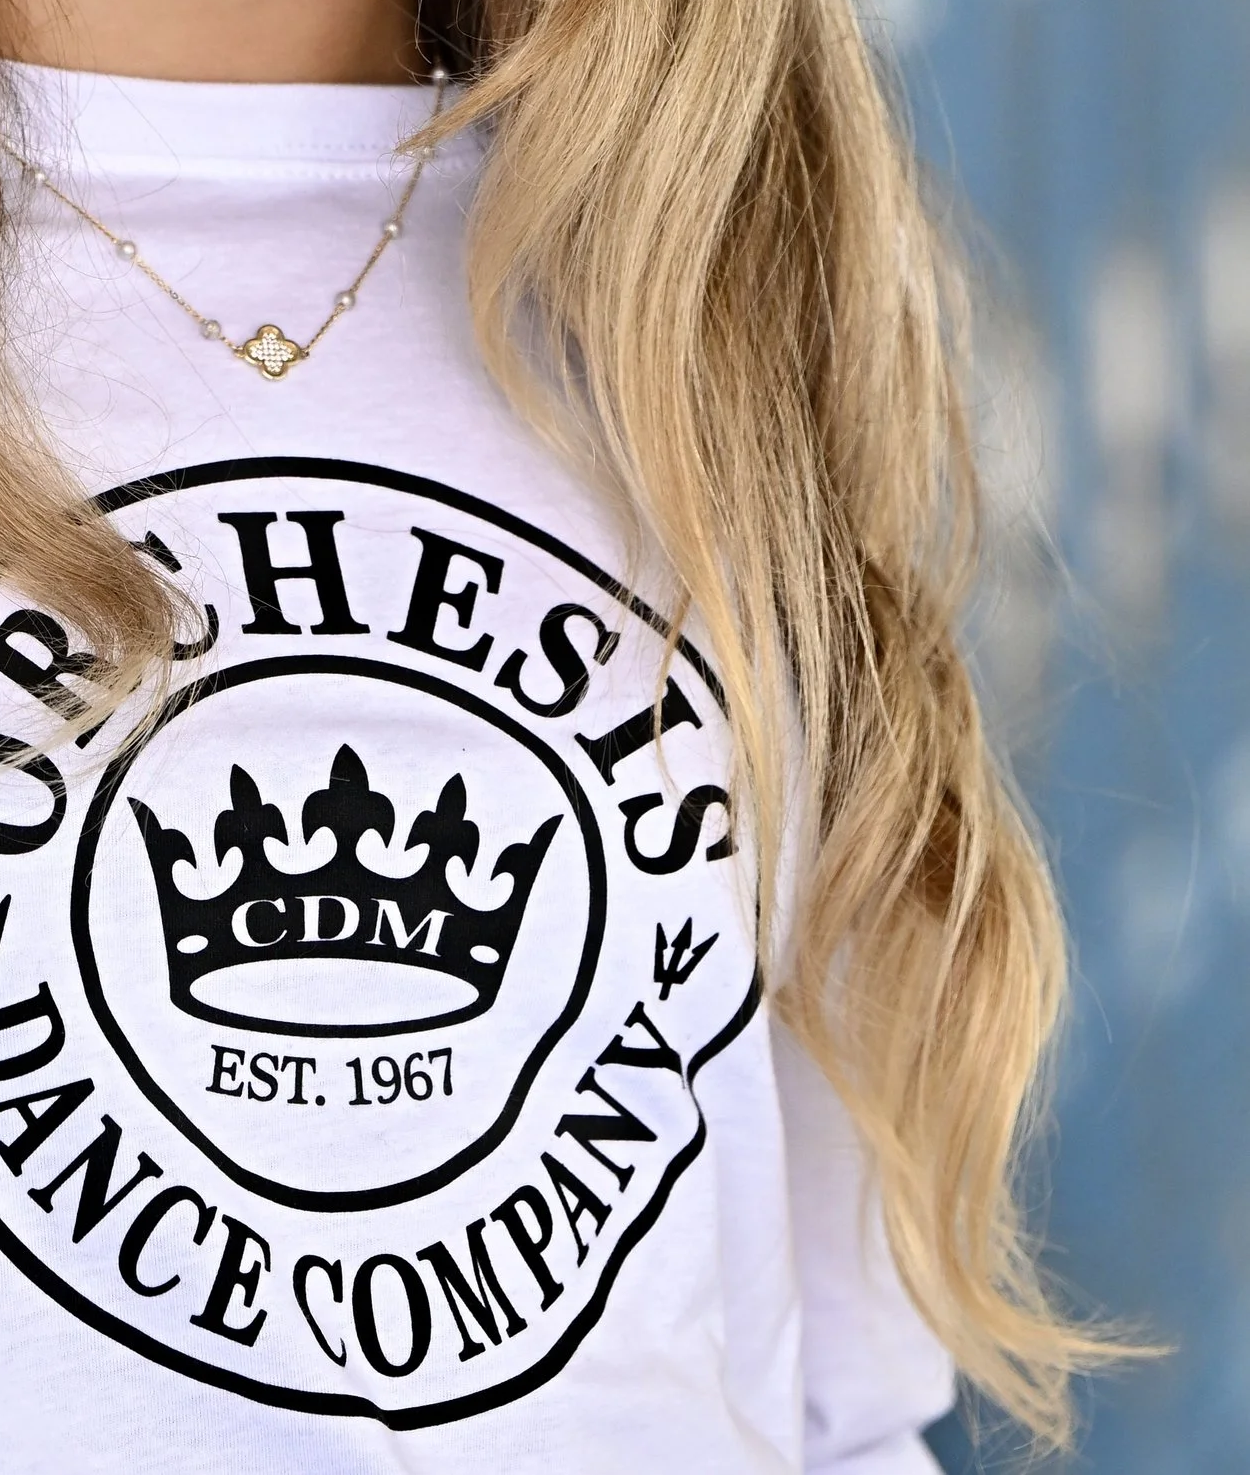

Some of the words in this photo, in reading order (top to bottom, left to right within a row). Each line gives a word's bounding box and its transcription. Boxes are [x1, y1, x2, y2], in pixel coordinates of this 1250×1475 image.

[231, 895, 454, 957] CDM
[206, 1044, 326, 1106] EST.
[345, 1047, 453, 1106] 1967
[292, 1000, 686, 1378] COMPANY
